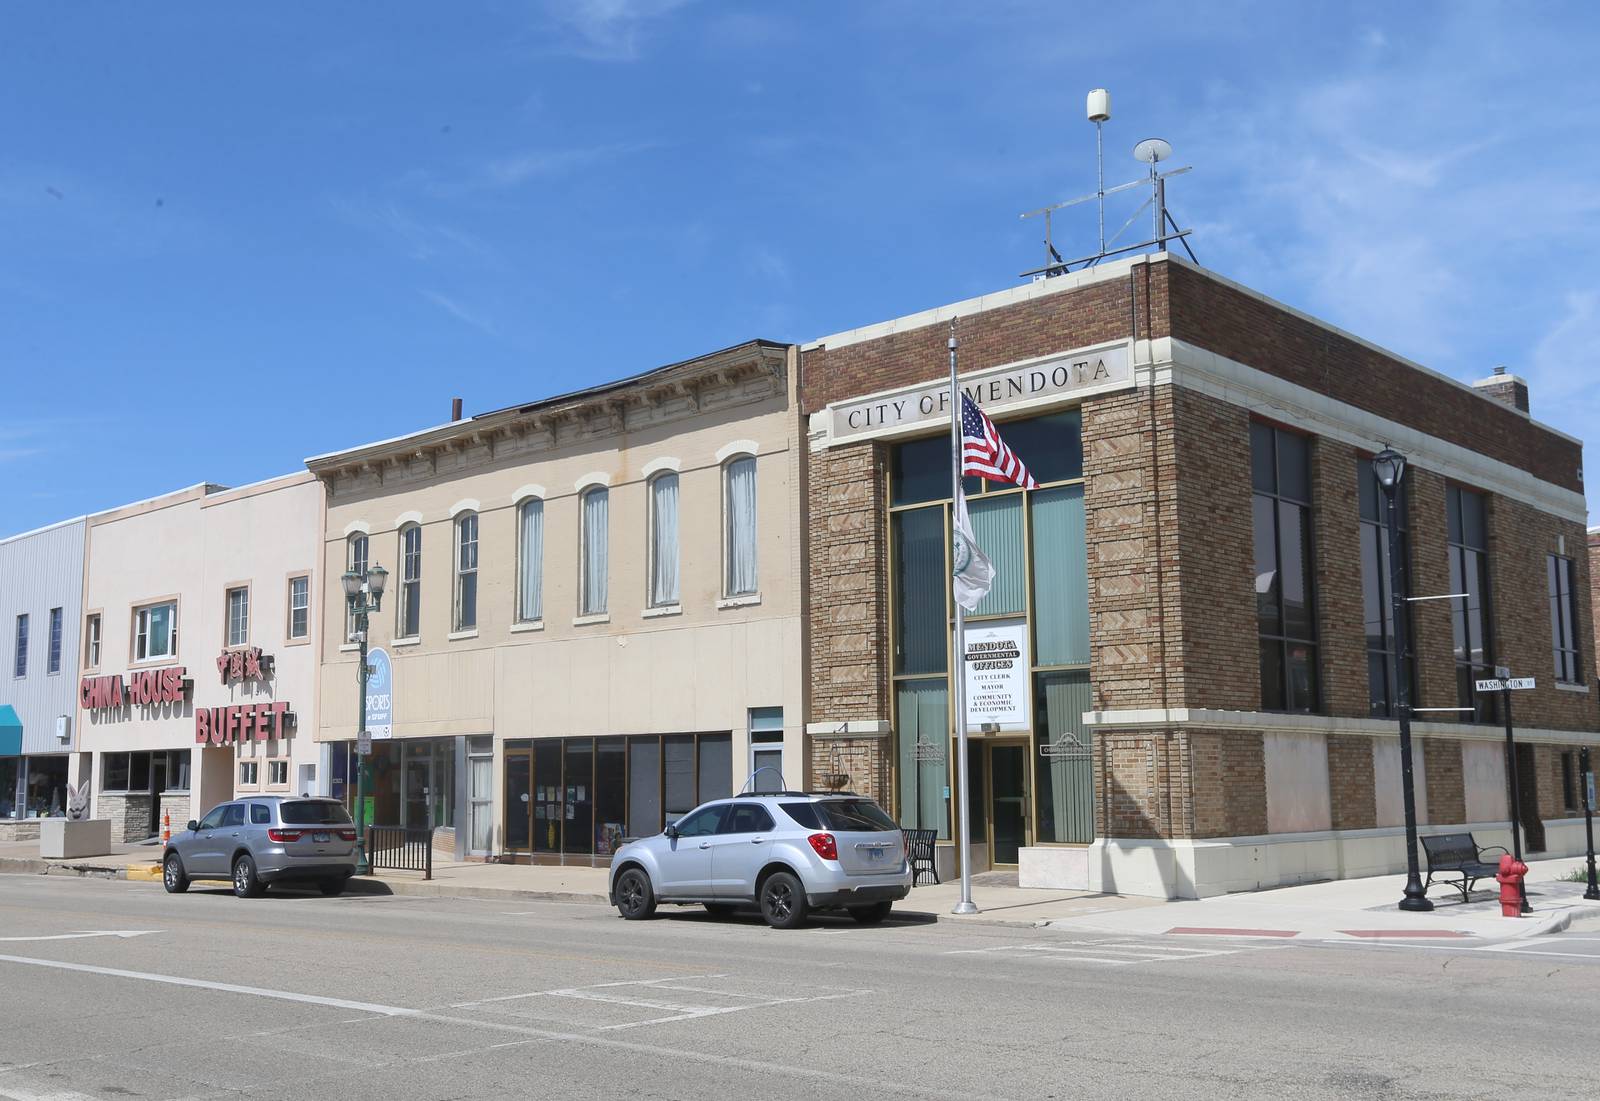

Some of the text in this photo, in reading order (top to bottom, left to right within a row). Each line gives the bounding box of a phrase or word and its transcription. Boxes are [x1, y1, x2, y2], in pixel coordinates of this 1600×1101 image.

[848, 358, 1110, 429] CITY OF MENDOTA
[968, 641, 1017, 652] MENDOTA
[972, 661, 1013, 670] OFFICES
[80, 667, 186, 710] CHINA HOUSE
[1477, 679, 1523, 690] WASHINGTON
[366, 694, 390, 710] SPORTS
[195, 701, 289, 744] BUFFET
